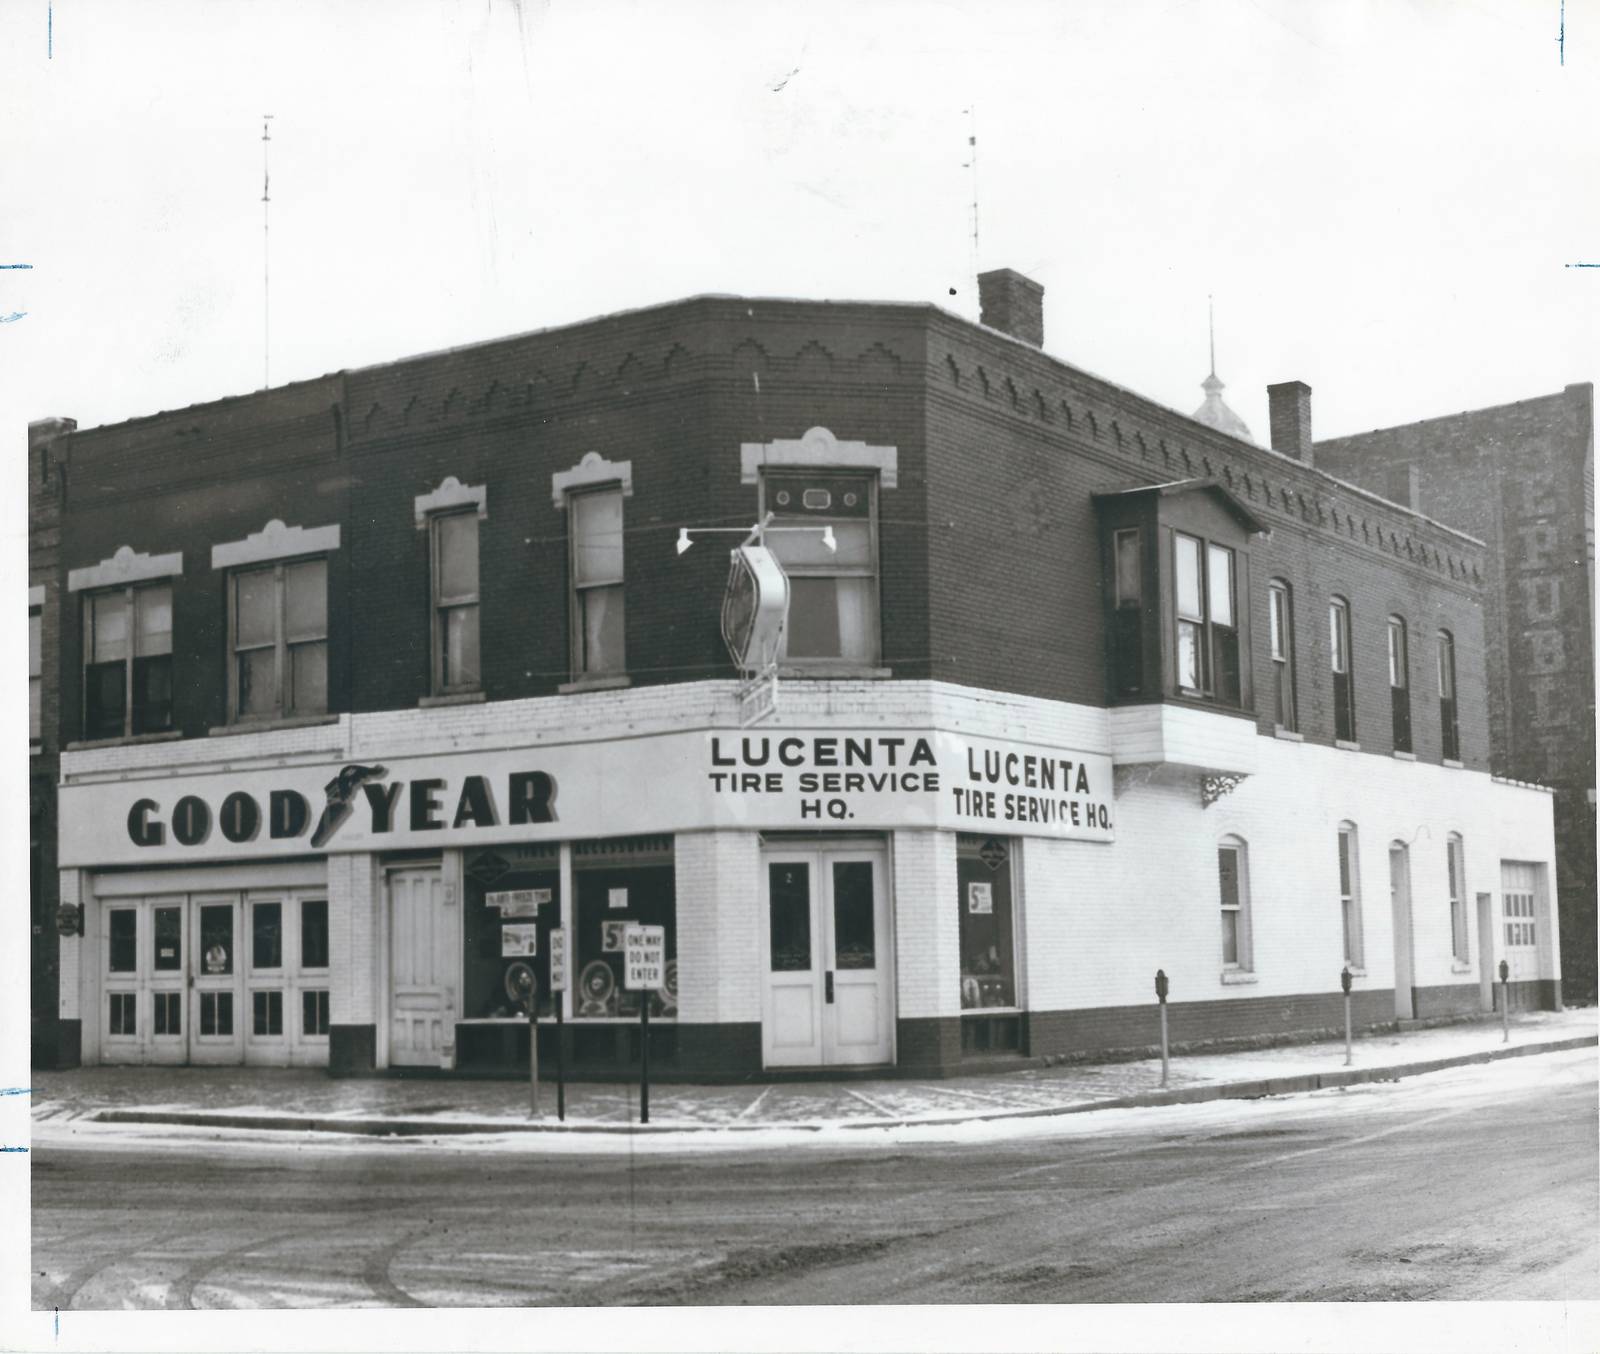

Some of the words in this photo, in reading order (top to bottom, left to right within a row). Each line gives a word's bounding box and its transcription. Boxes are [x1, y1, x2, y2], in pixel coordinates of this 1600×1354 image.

[711, 737, 937, 767] LUCENTA
[968, 747, 1091, 795] LUCENTA
[708, 772, 784, 793] TIRE
[799, 772, 940, 793] SERVICE
[800, 798, 856, 820] HQ.
[952, 787, 997, 819] TIRE
[1004, 793, 1081, 826] SERVICE
[1086, 803, 1113, 830] HQ.
[627, 934, 643, 947] ONE
[645, 935, 662, 946] WAY
[629, 951, 642, 964] DO
[643, 951, 661, 964] NOT
[630, 967, 659, 981] ENTER
